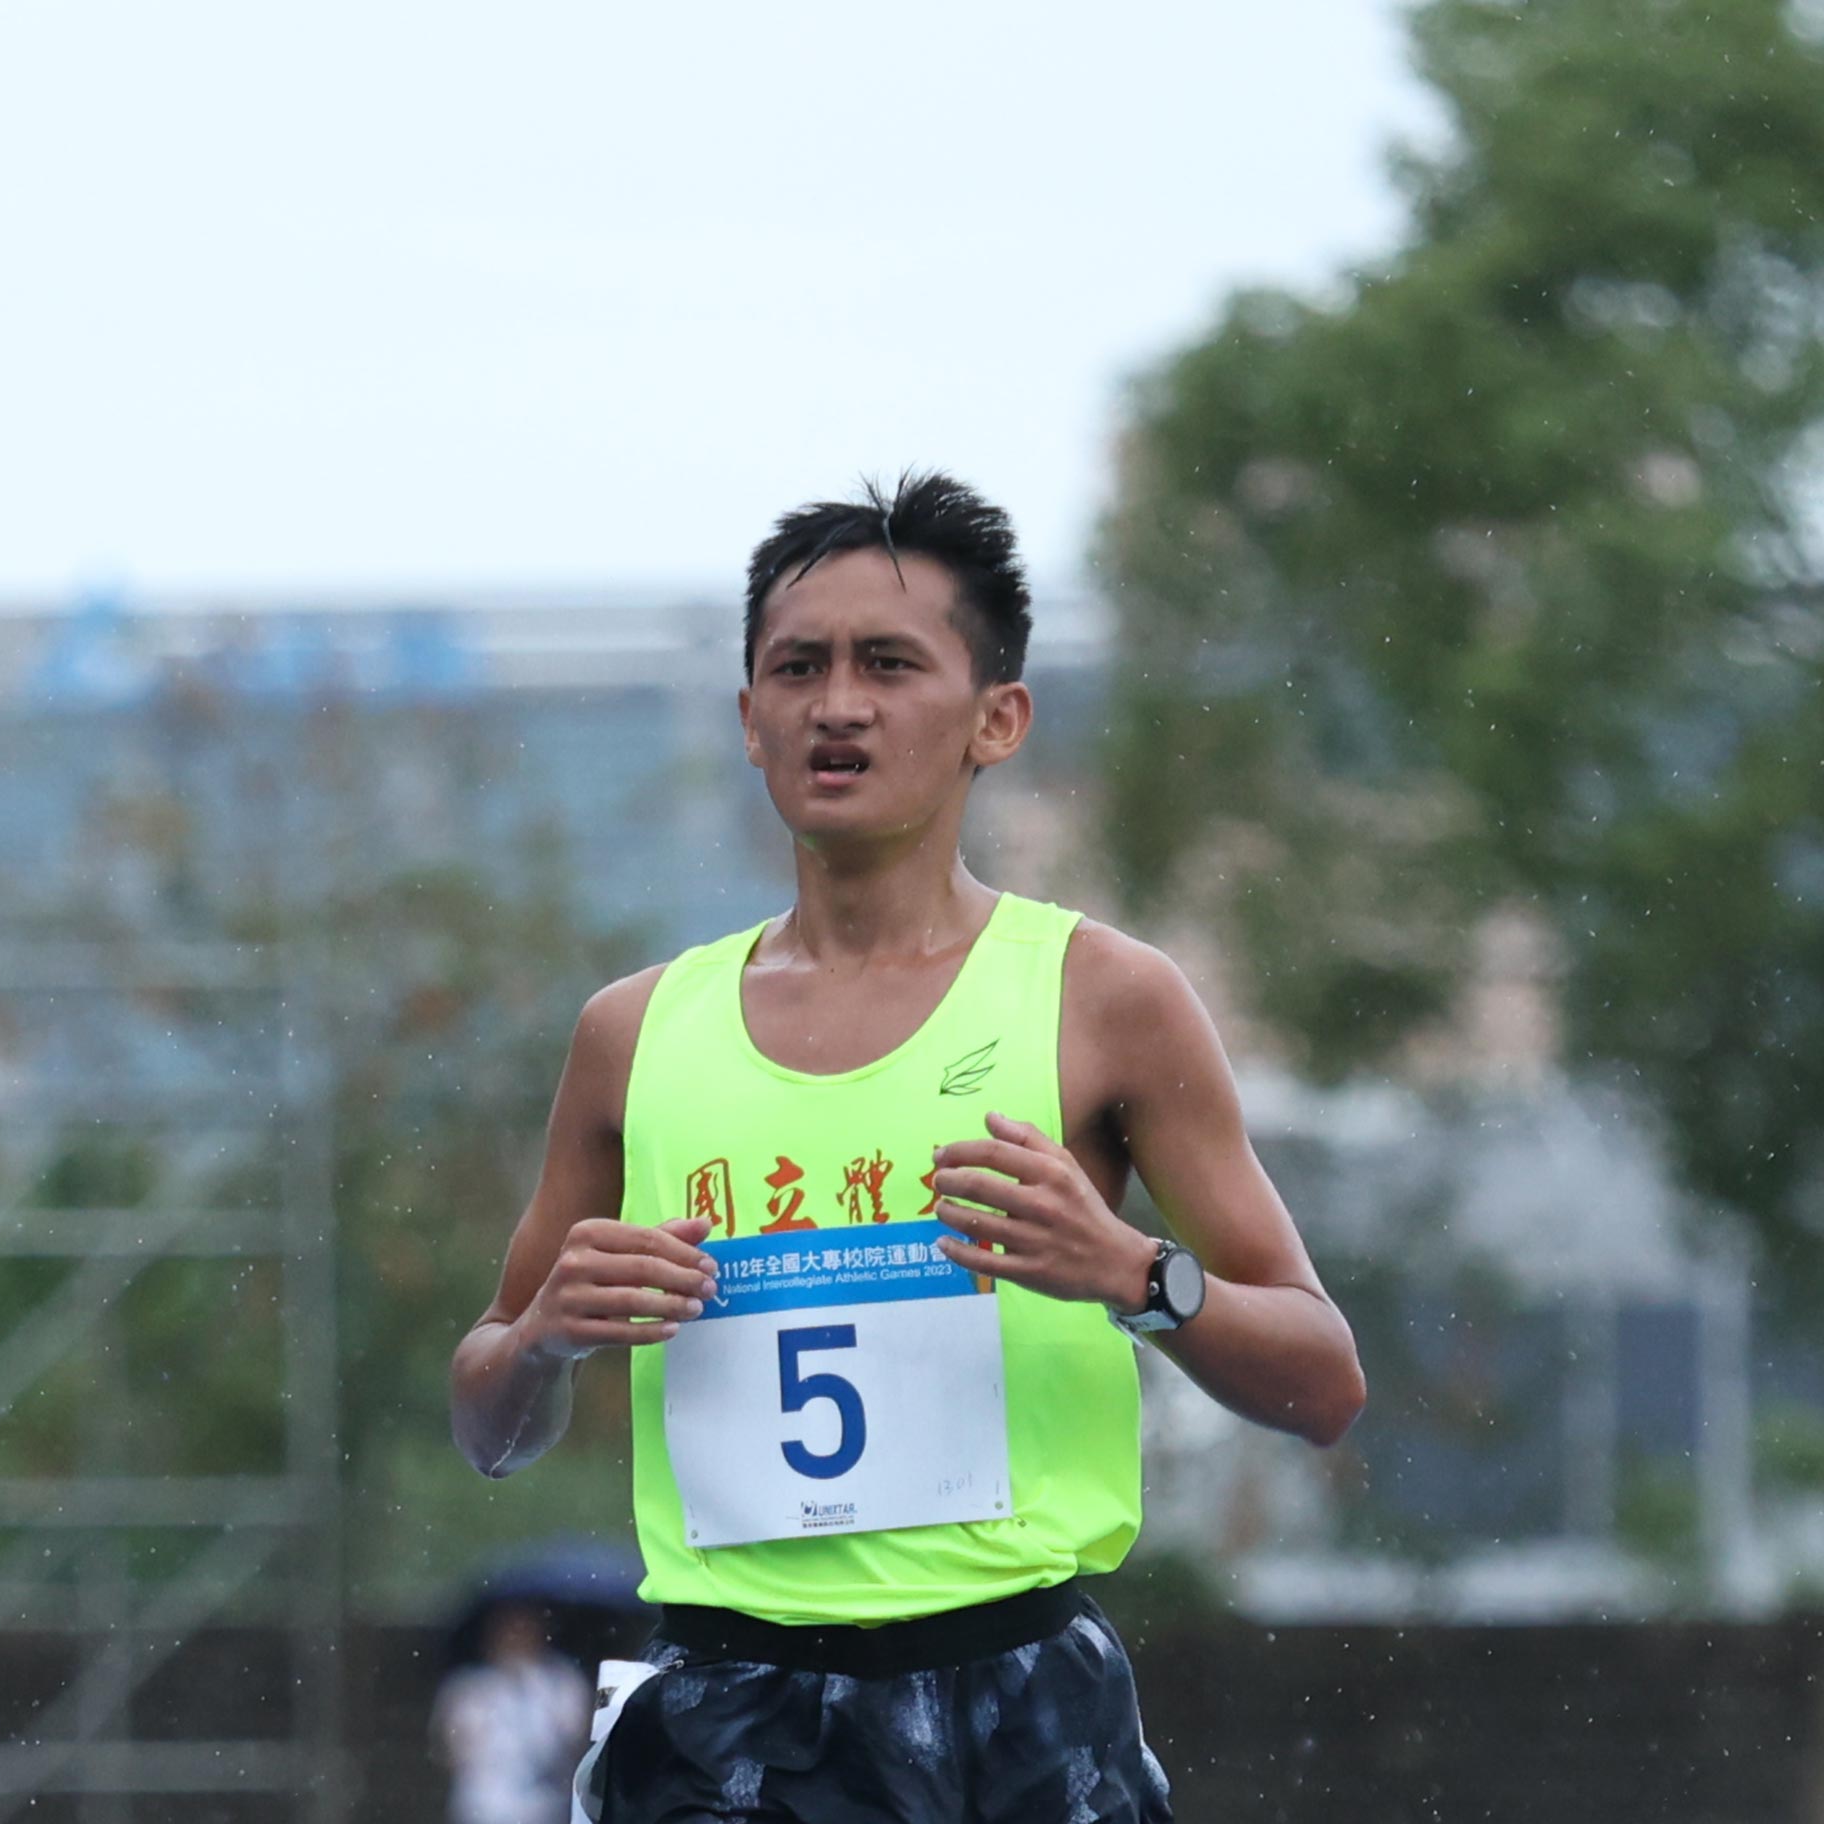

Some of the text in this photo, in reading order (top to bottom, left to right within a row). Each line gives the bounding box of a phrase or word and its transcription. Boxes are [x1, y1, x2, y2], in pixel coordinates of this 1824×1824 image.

[722, 1263, 953, 1295] National Intercollegiate Athletic Games 2023
[777, 1323, 868, 1480] 5
